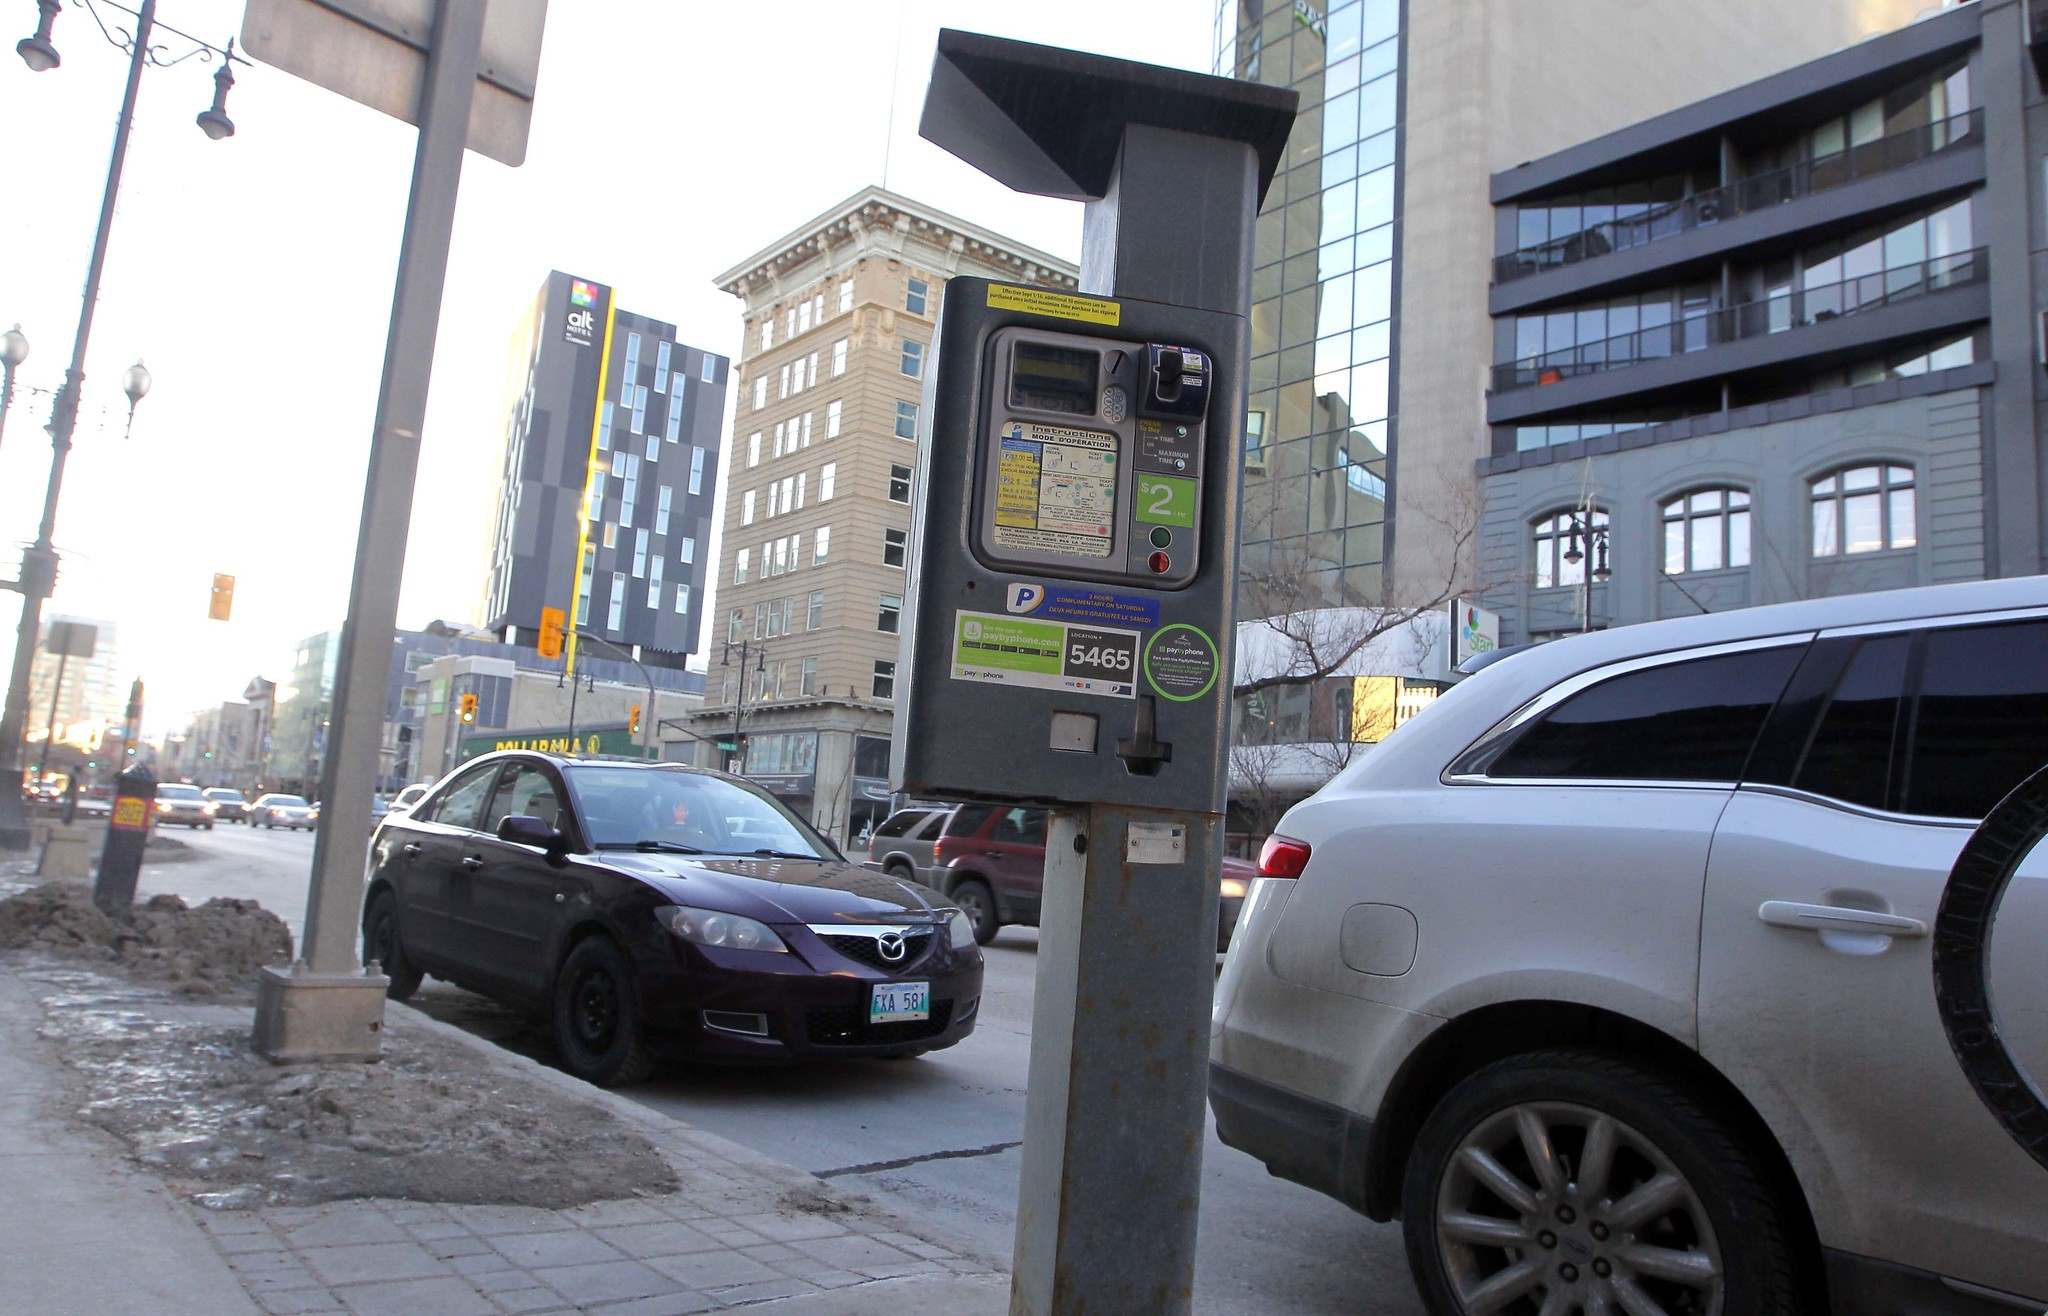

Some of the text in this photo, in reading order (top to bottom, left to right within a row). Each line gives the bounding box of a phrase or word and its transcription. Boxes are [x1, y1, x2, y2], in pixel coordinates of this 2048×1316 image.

[990, 294, 1013, 302] purchased
[1002, 287, 1021, 296] Effective
[568, 311, 593, 330] alt
[566, 324, 591, 336] HOTEL
[1031, 433, 1054, 442] MODE
[1032, 424, 1111, 441] Instructions
[1158, 450, 1189, 459] MAXIMUM
[1015, 588, 1034, 607] P
[1056, 597, 1106, 608] COMPLIMENTARY
[1115, 603, 1144, 612] SATURDAY
[983, 631, 1060, 647] paybyphone.com
[1071, 632, 1098, 640] LOCATION
[1070, 644, 1131, 670] 5465
[903, 992, 924, 1010] 581
